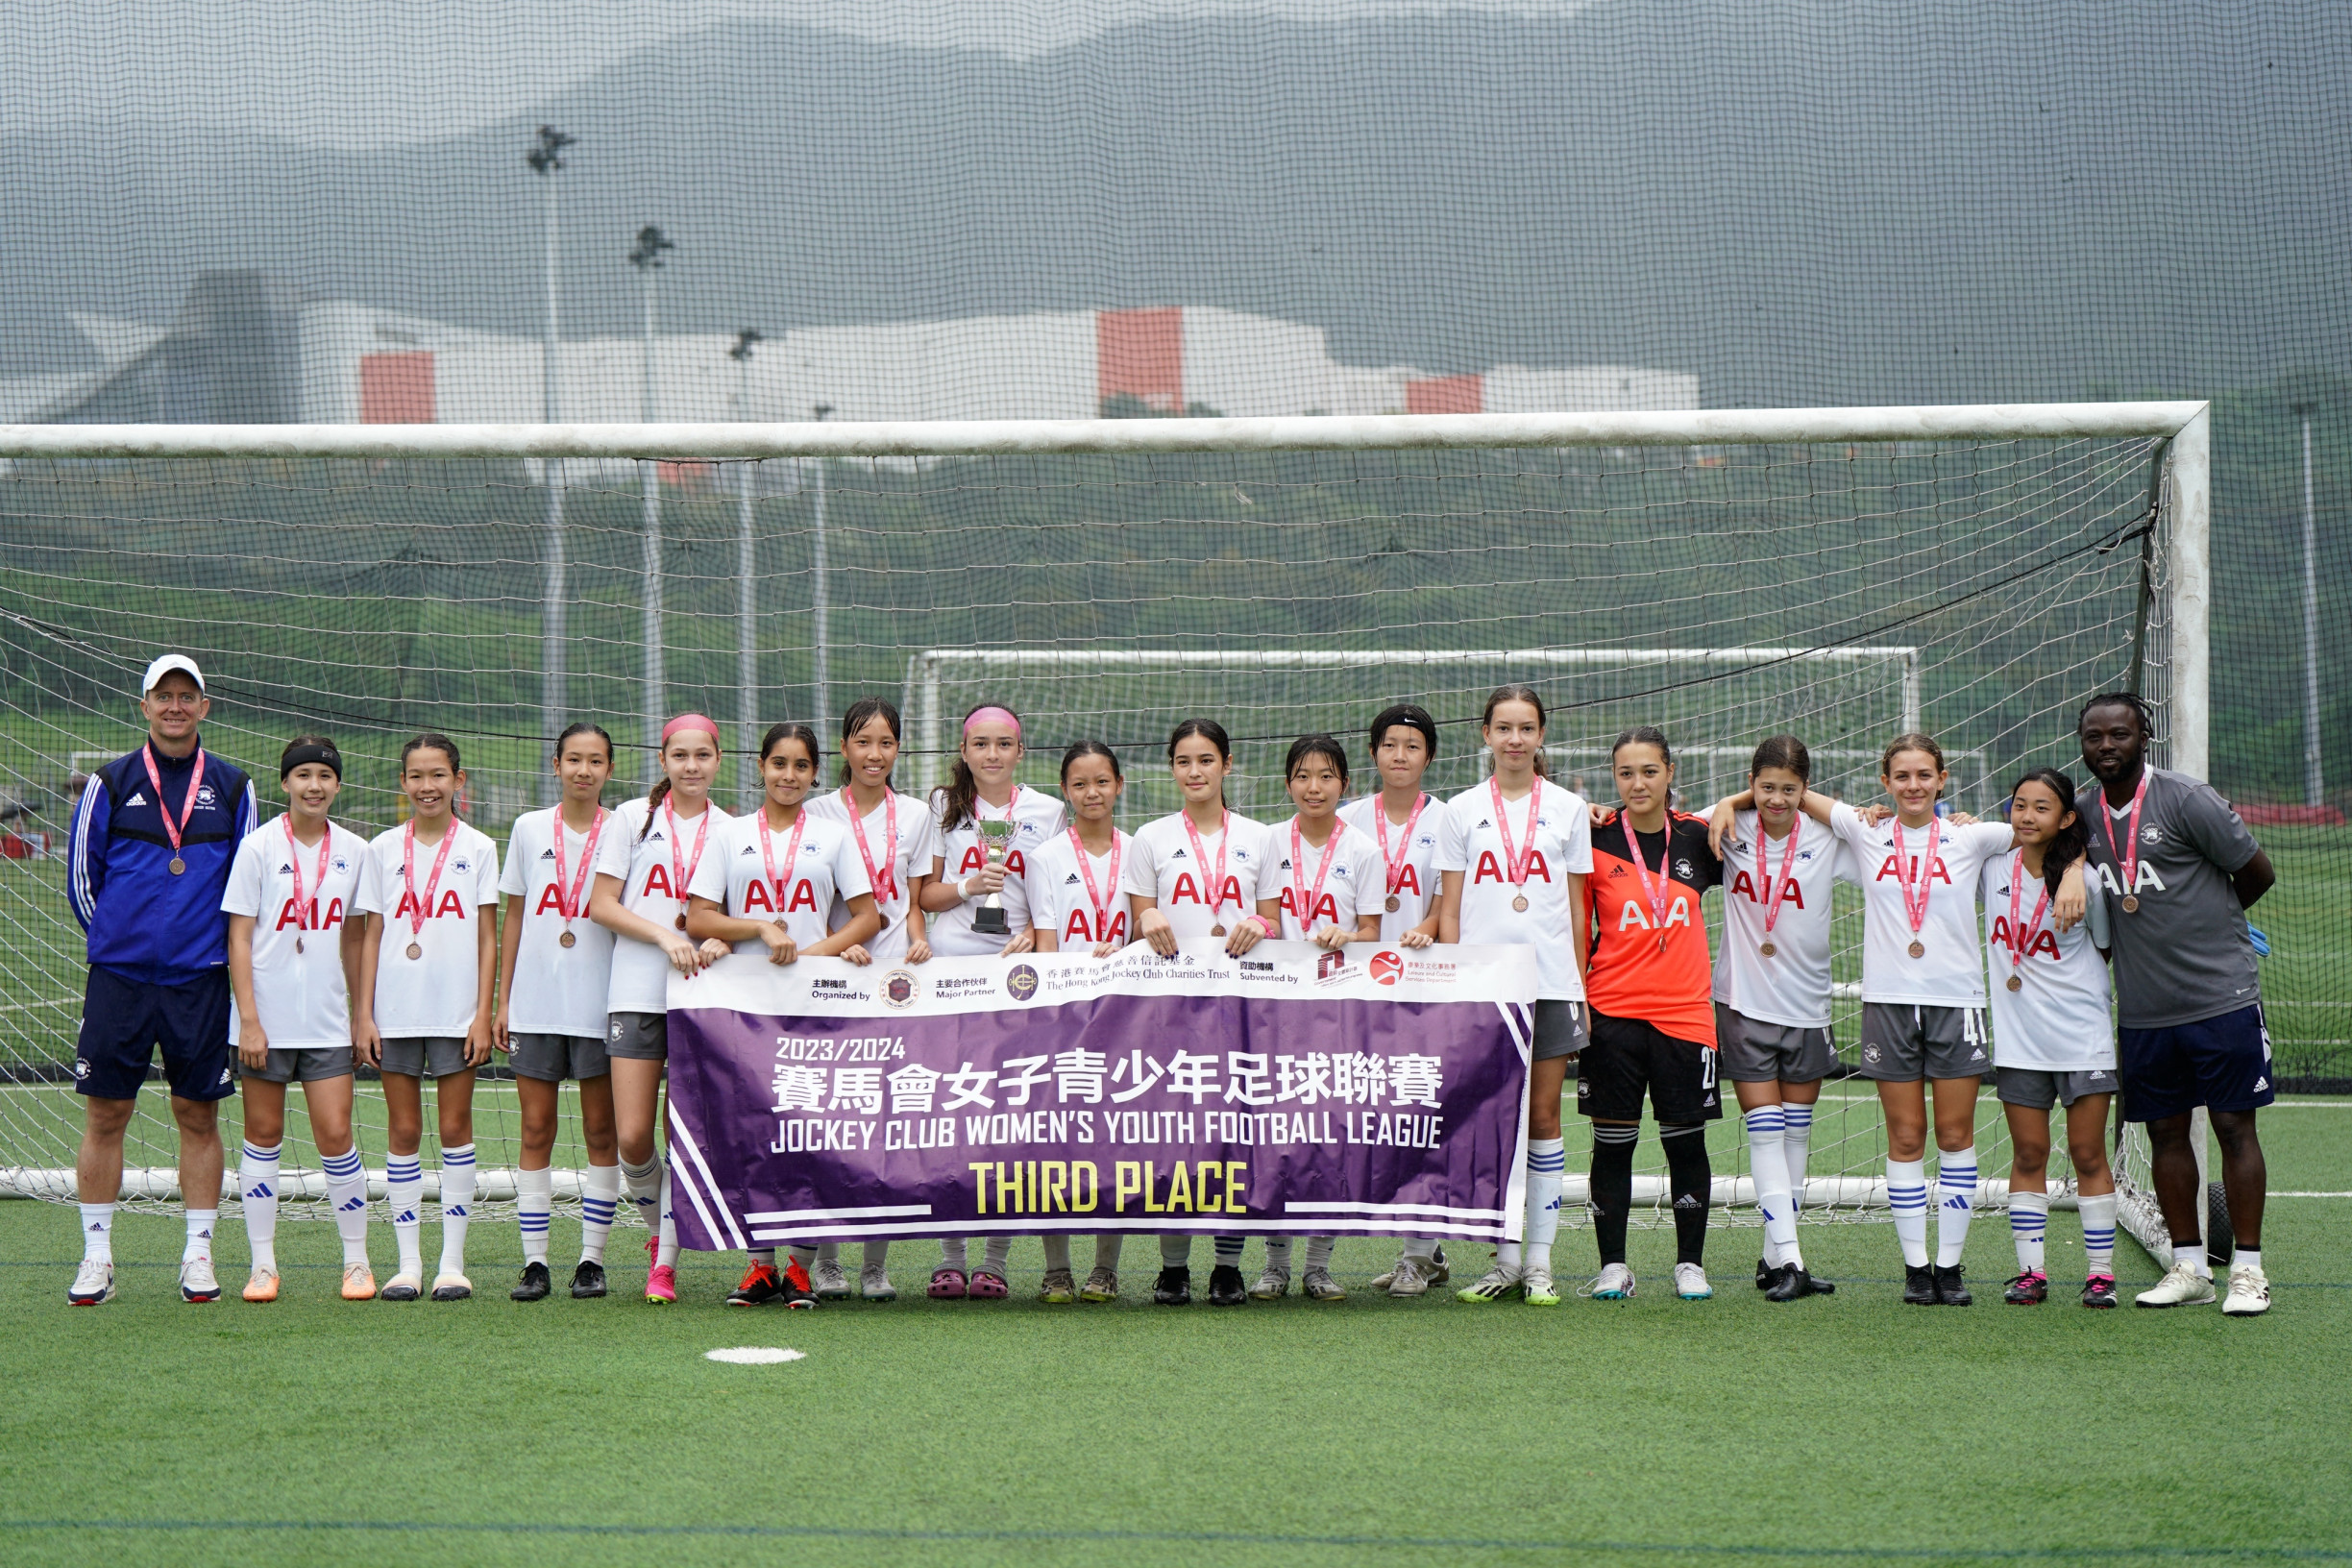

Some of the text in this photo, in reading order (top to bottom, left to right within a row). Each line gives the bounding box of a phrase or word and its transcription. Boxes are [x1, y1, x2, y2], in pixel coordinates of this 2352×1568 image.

[960, 846, 1025, 879] AA
[1876, 855, 1951, 884] AIA
[2097, 860, 2167, 895] AIA
[745, 878, 817, 914] AIA
[1731, 870, 1804, 910] AIA
[276, 897, 343, 931] AIA
[1065, 908, 1126, 945] AIA
[1991, 916, 2061, 960] AIA
[1046, 968, 1230, 991] The Hong Kong Jockey Club Charities Trust
[1239, 961, 1274, 971] 資助機構
[1240, 972, 1298, 984] Subvented by
[812, 991, 870, 1001] Organized by
[936, 989, 995, 999] Major Partner
[776, 1037, 906, 1062] 2023/2024
[771, 1046, 1443, 1115] 賽馬會女子青少年足球聯賽
[771, 1110, 1444, 1154] JOCKEY CLUB WOMEN'S YOUTH FOOTBALL LEAGUE
[968, 1160, 1247, 1214] THIRD PLACE
